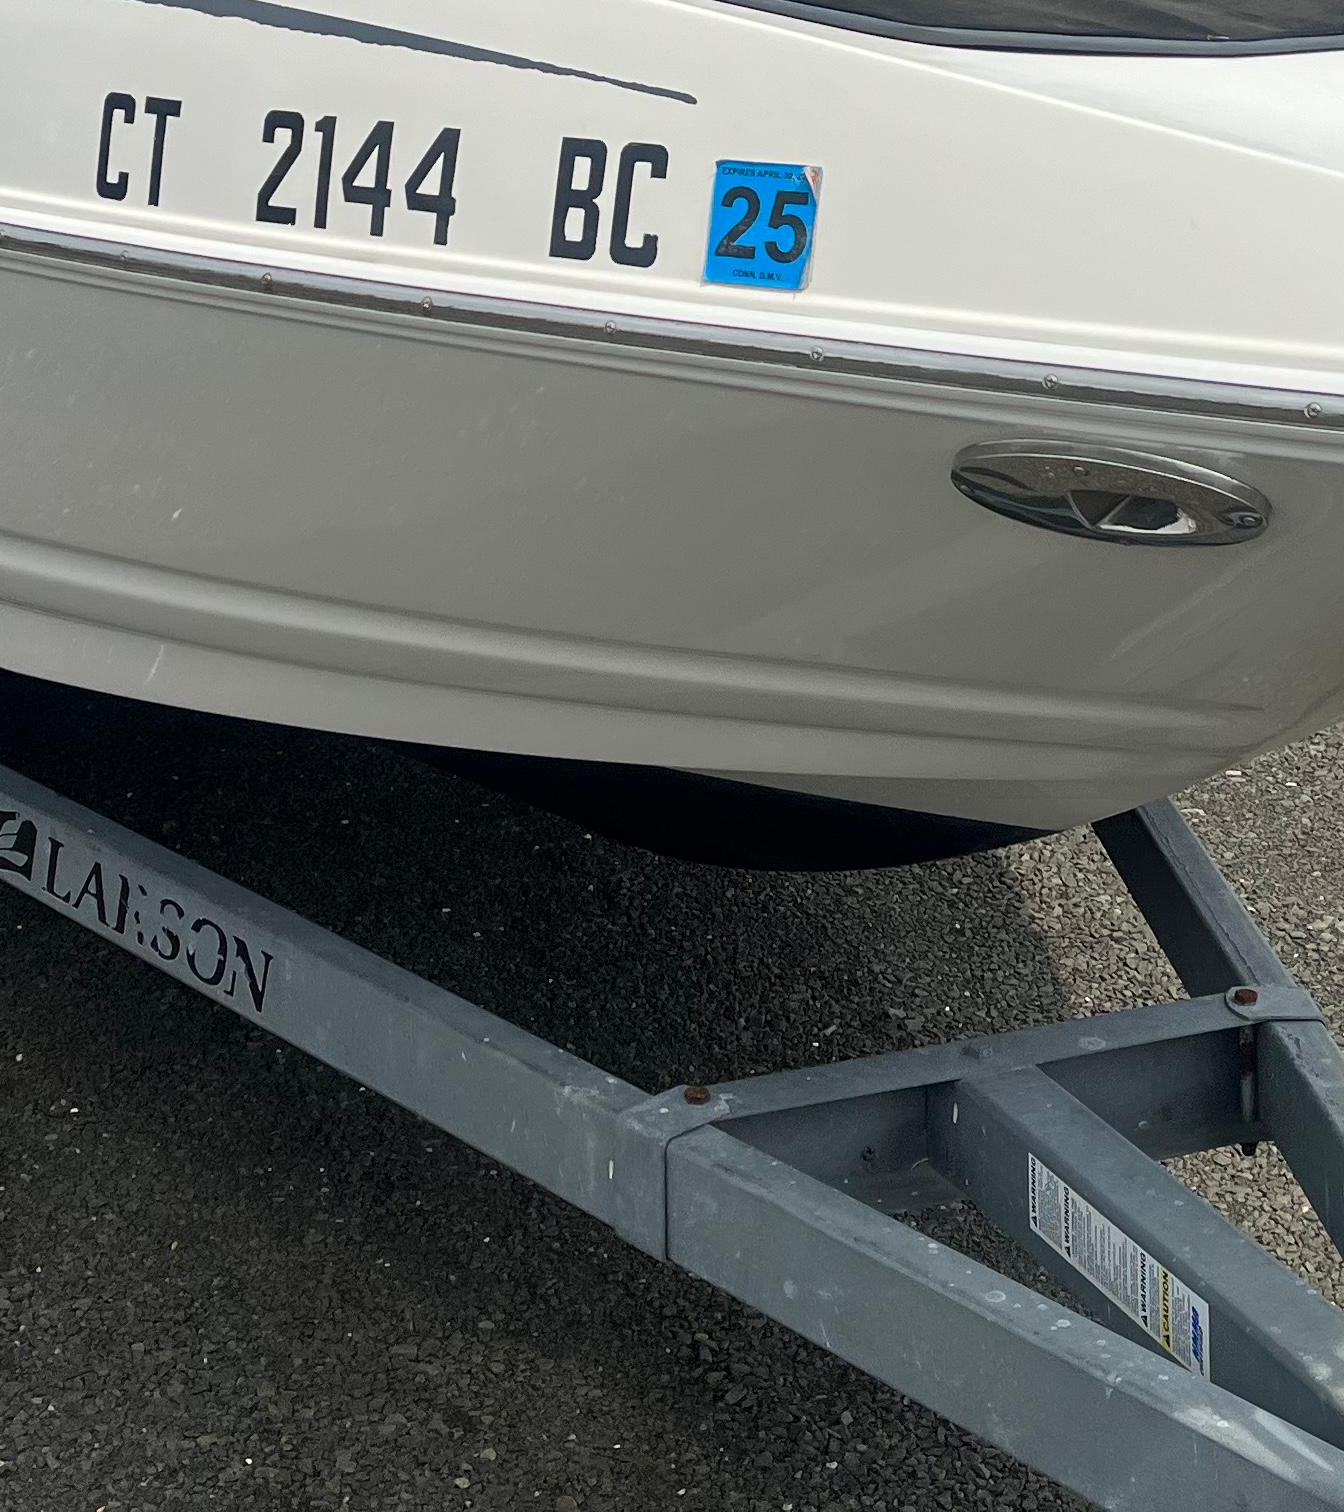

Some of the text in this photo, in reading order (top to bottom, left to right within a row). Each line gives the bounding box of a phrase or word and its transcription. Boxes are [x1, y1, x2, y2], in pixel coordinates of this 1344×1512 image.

[95, 91, 669, 268] CT 2144 BC
[721, 166, 756, 177] EXPIRES
[756, 168, 782, 180] APRIL
[714, 185, 810, 265] 25
[1162, 1270, 1170, 1333] CAUTION
